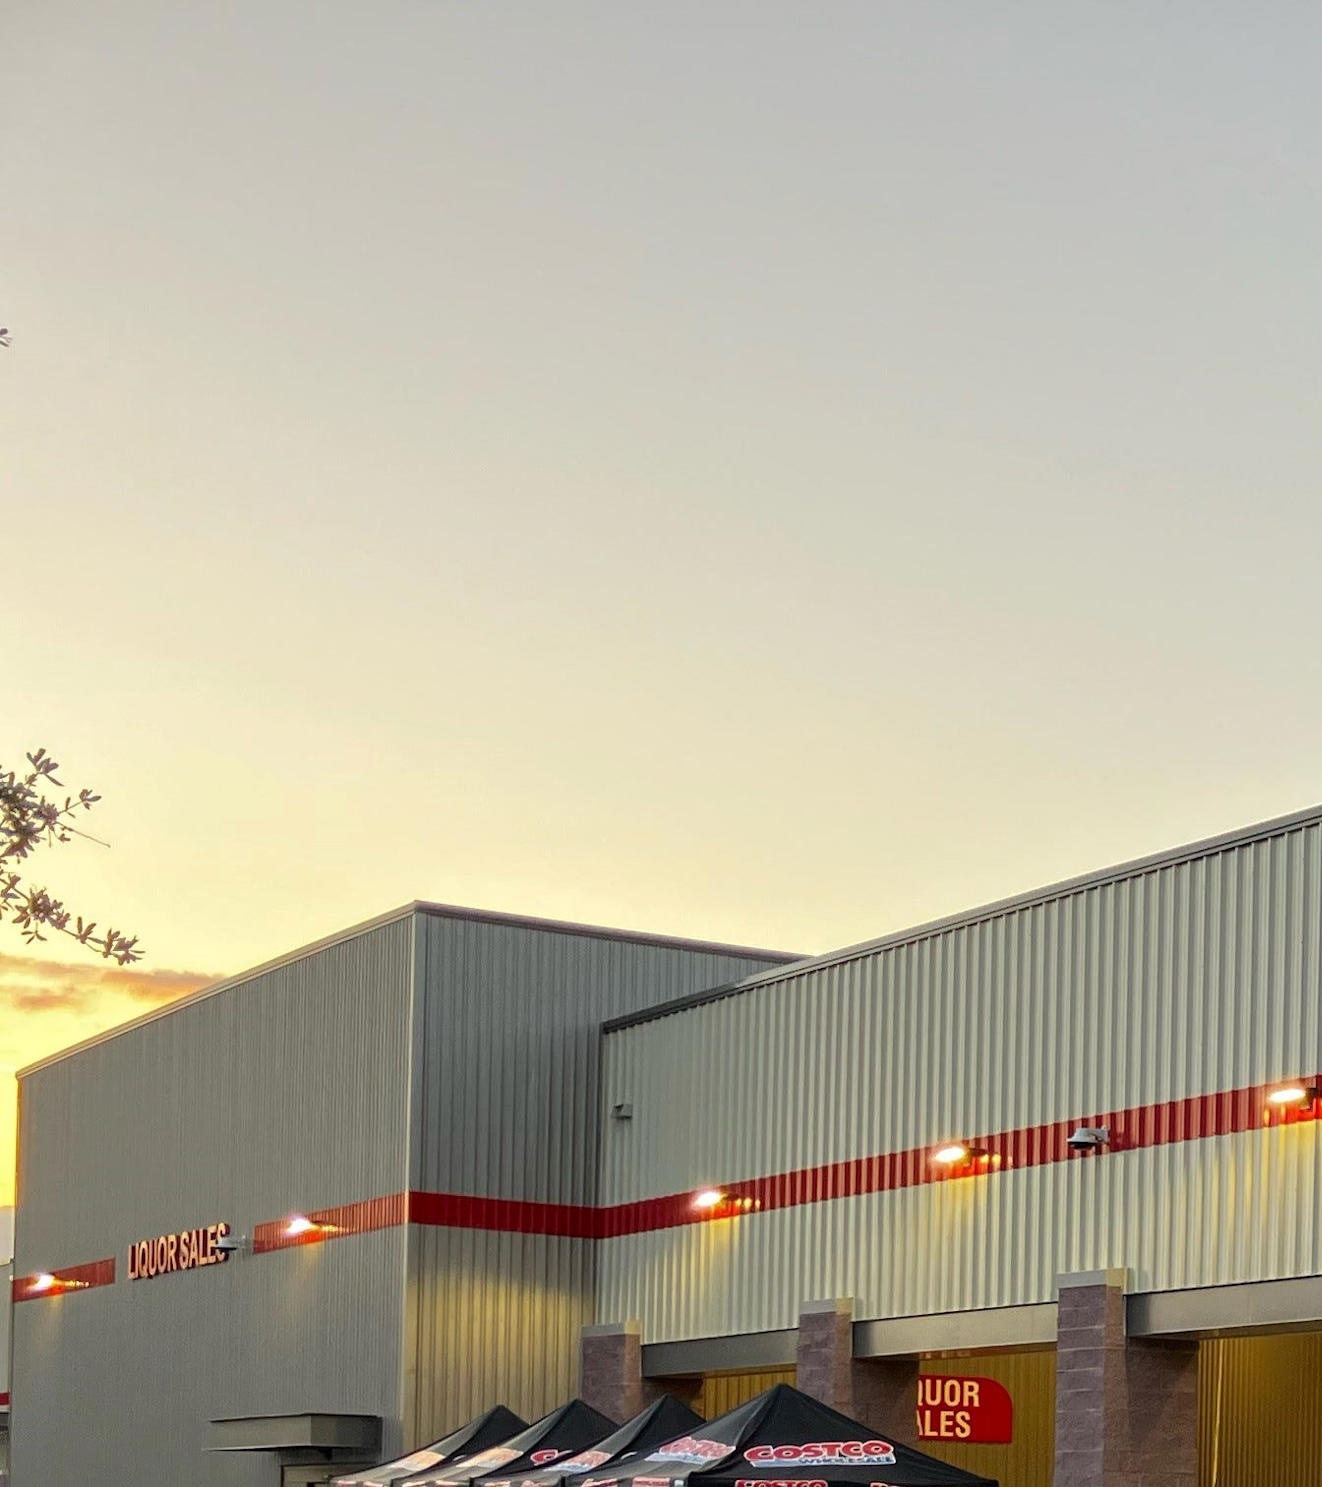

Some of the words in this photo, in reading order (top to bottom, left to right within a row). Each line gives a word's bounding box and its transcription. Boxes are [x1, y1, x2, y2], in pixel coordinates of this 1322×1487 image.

[128, 1234, 178, 1279] LIQUOR
[180, 1222, 228, 1269] SALES
[744, 1440, 894, 1461] COSTCO
